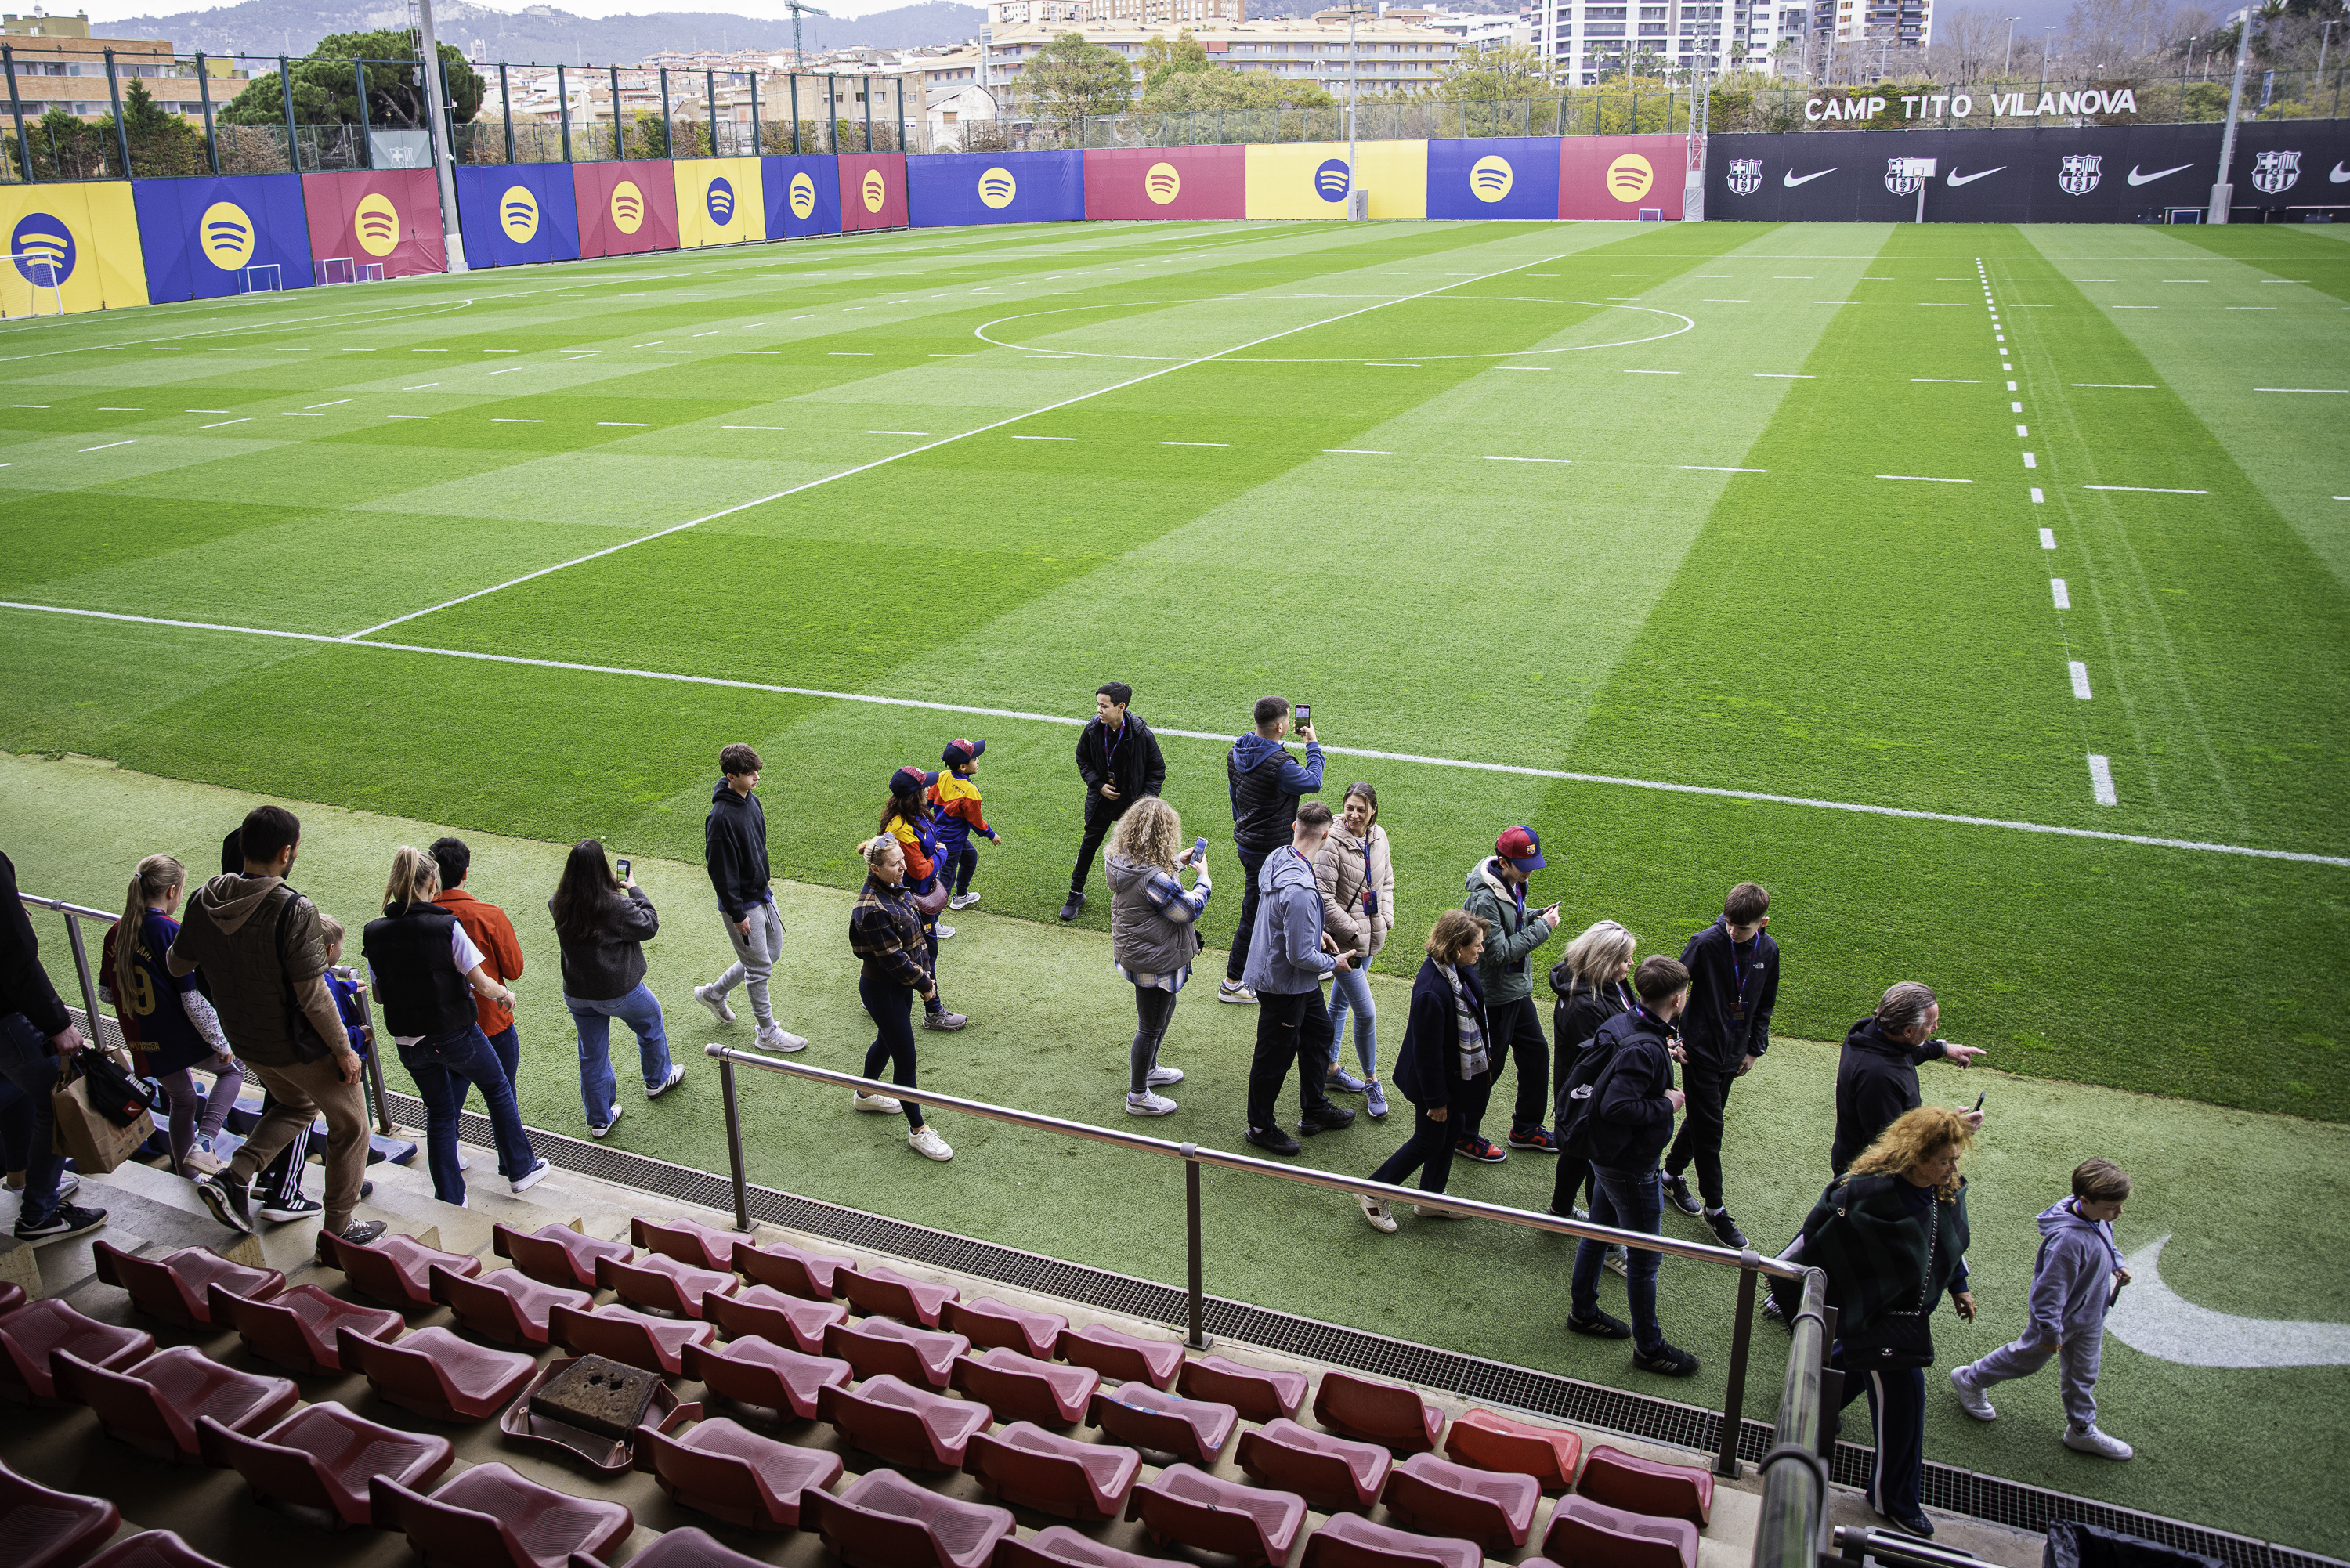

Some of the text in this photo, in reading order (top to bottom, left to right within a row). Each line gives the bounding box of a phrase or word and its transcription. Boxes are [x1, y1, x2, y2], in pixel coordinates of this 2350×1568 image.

[1804, 89, 2137, 121] CAMP TITO VILANOVA
[125, 1073, 152, 1097] NIKE
